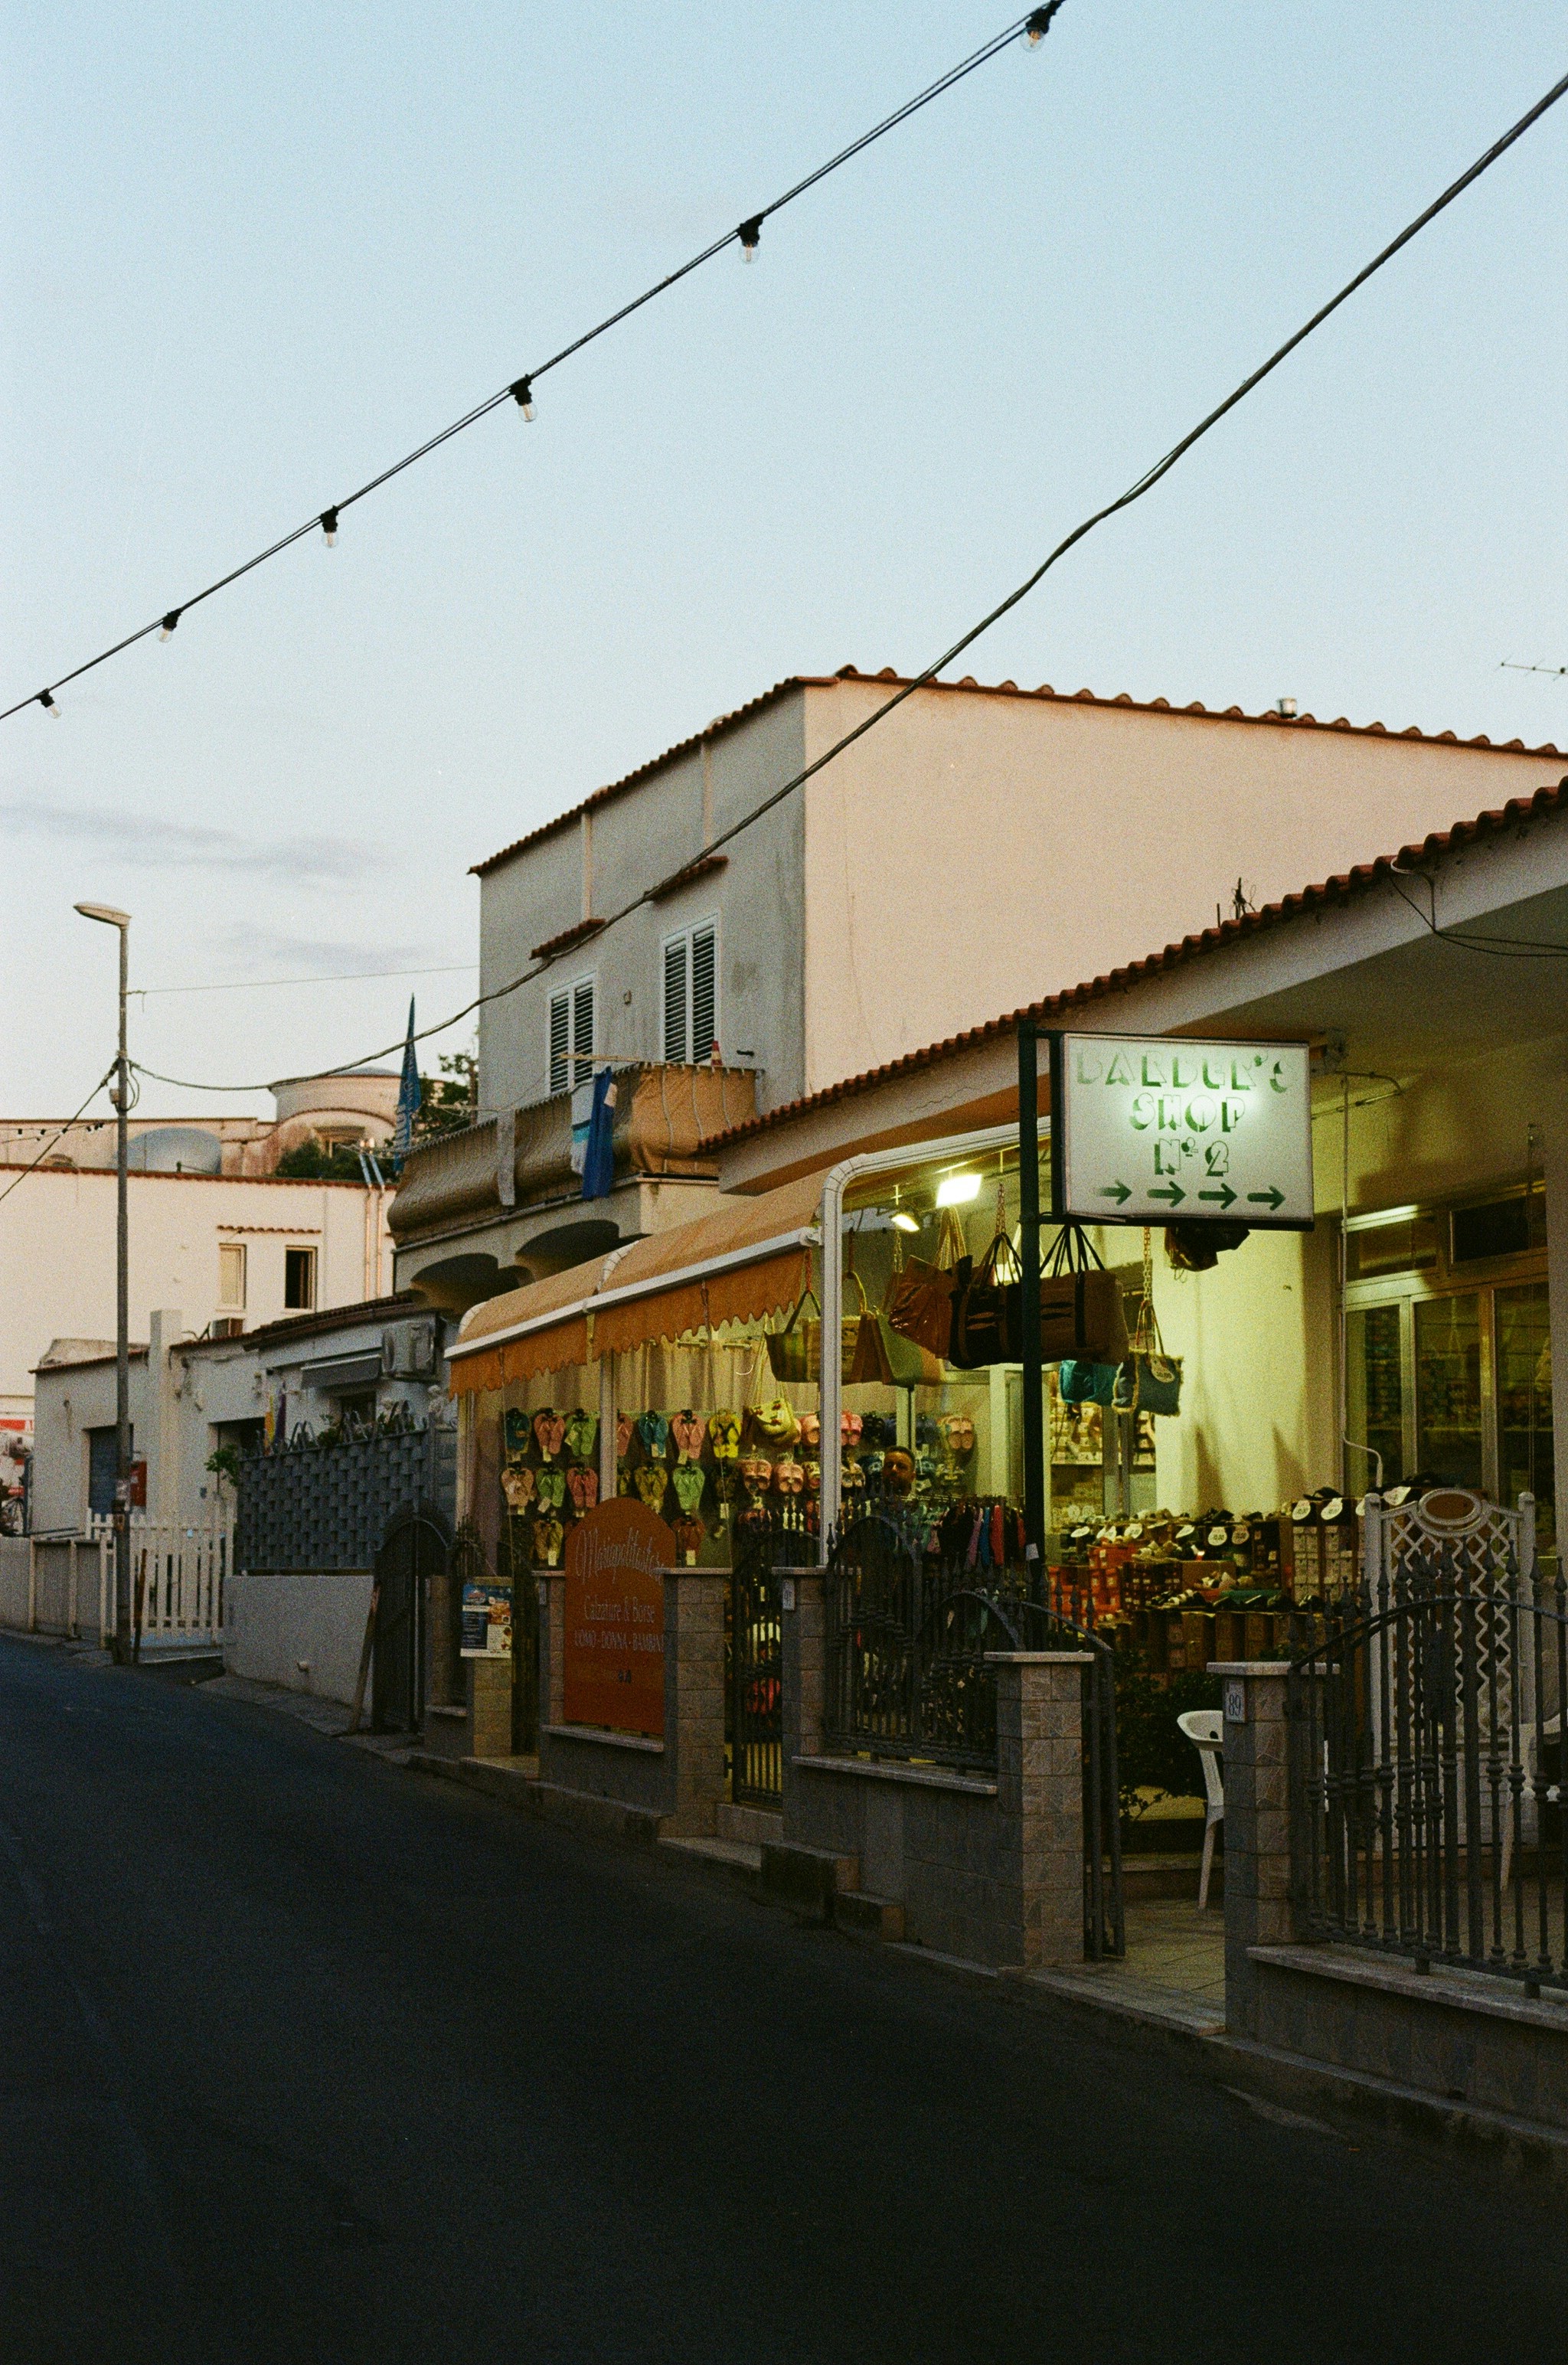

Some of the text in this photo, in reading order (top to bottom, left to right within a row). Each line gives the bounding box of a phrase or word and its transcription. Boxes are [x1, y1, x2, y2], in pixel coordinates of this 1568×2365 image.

[1129, 1093, 1246, 1132] SHOP
[1205, 1140, 1229, 1177] 2
[601, 1631, 628, 1650] DONNA
[1228, 1694, 1242, 1717] 89
